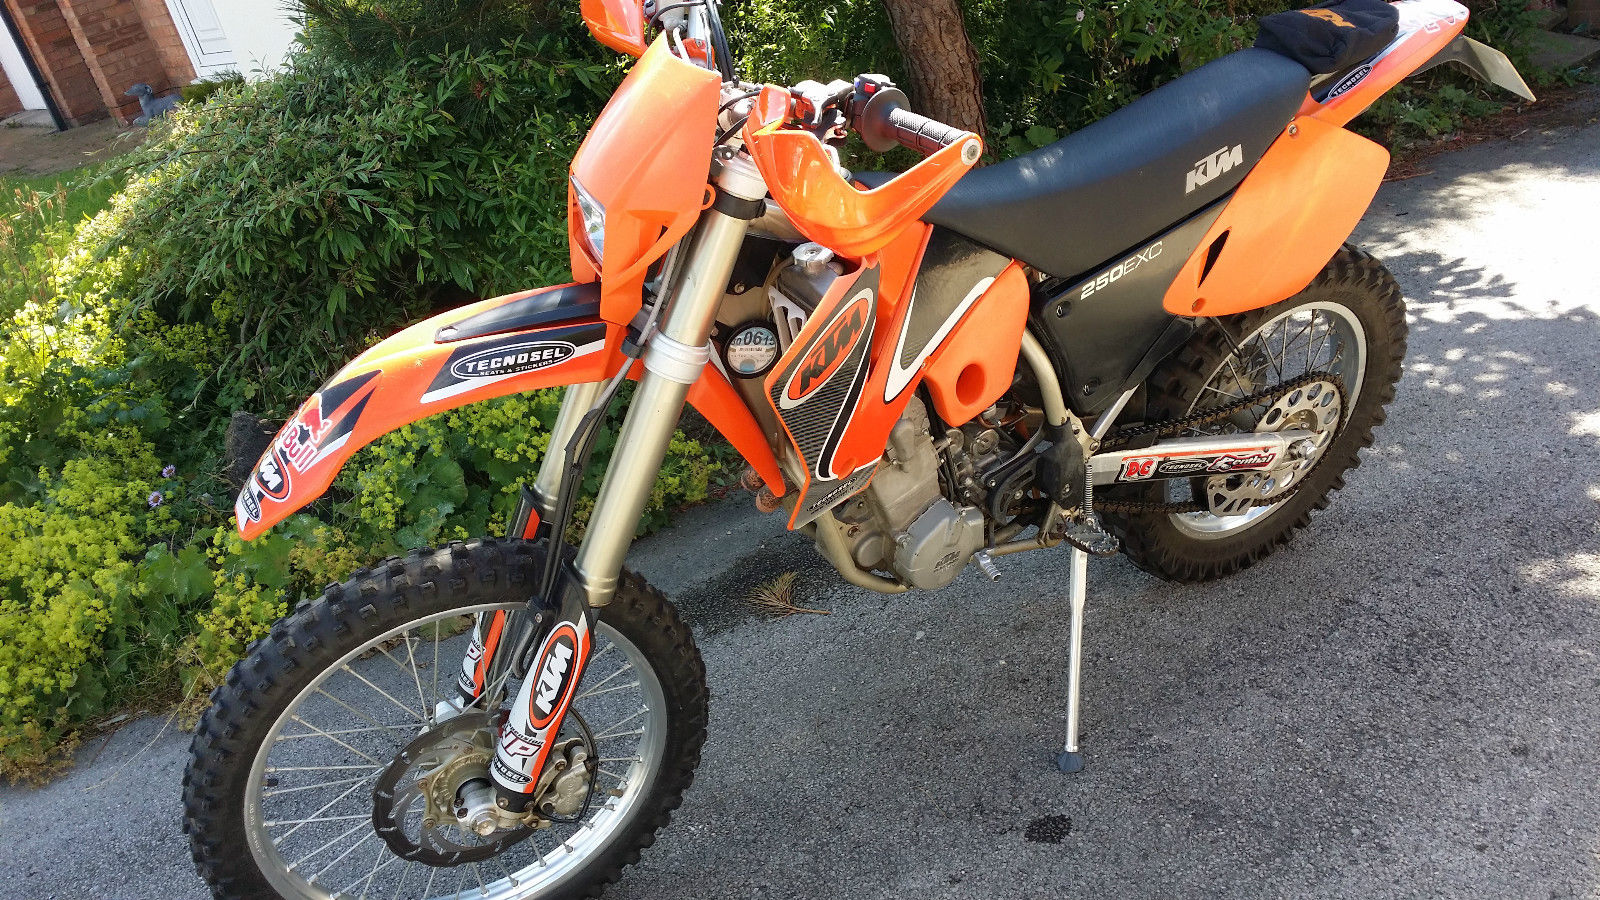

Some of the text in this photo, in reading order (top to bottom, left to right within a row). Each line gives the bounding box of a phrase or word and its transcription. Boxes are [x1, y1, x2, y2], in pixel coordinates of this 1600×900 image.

[1332, 68, 1368, 97] TECNOSEL
[1185, 143, 1243, 194] KTM
[1080, 240, 1163, 300] 250EXC
[465, 347, 566, 374] TECNOSEL
[515, 359, 554, 372] STICKERS
[799, 305, 862, 396] KTM
[281, 426, 316, 469] Bull
[259, 448, 283, 491] TM
[535, 642, 574, 715] KTM
